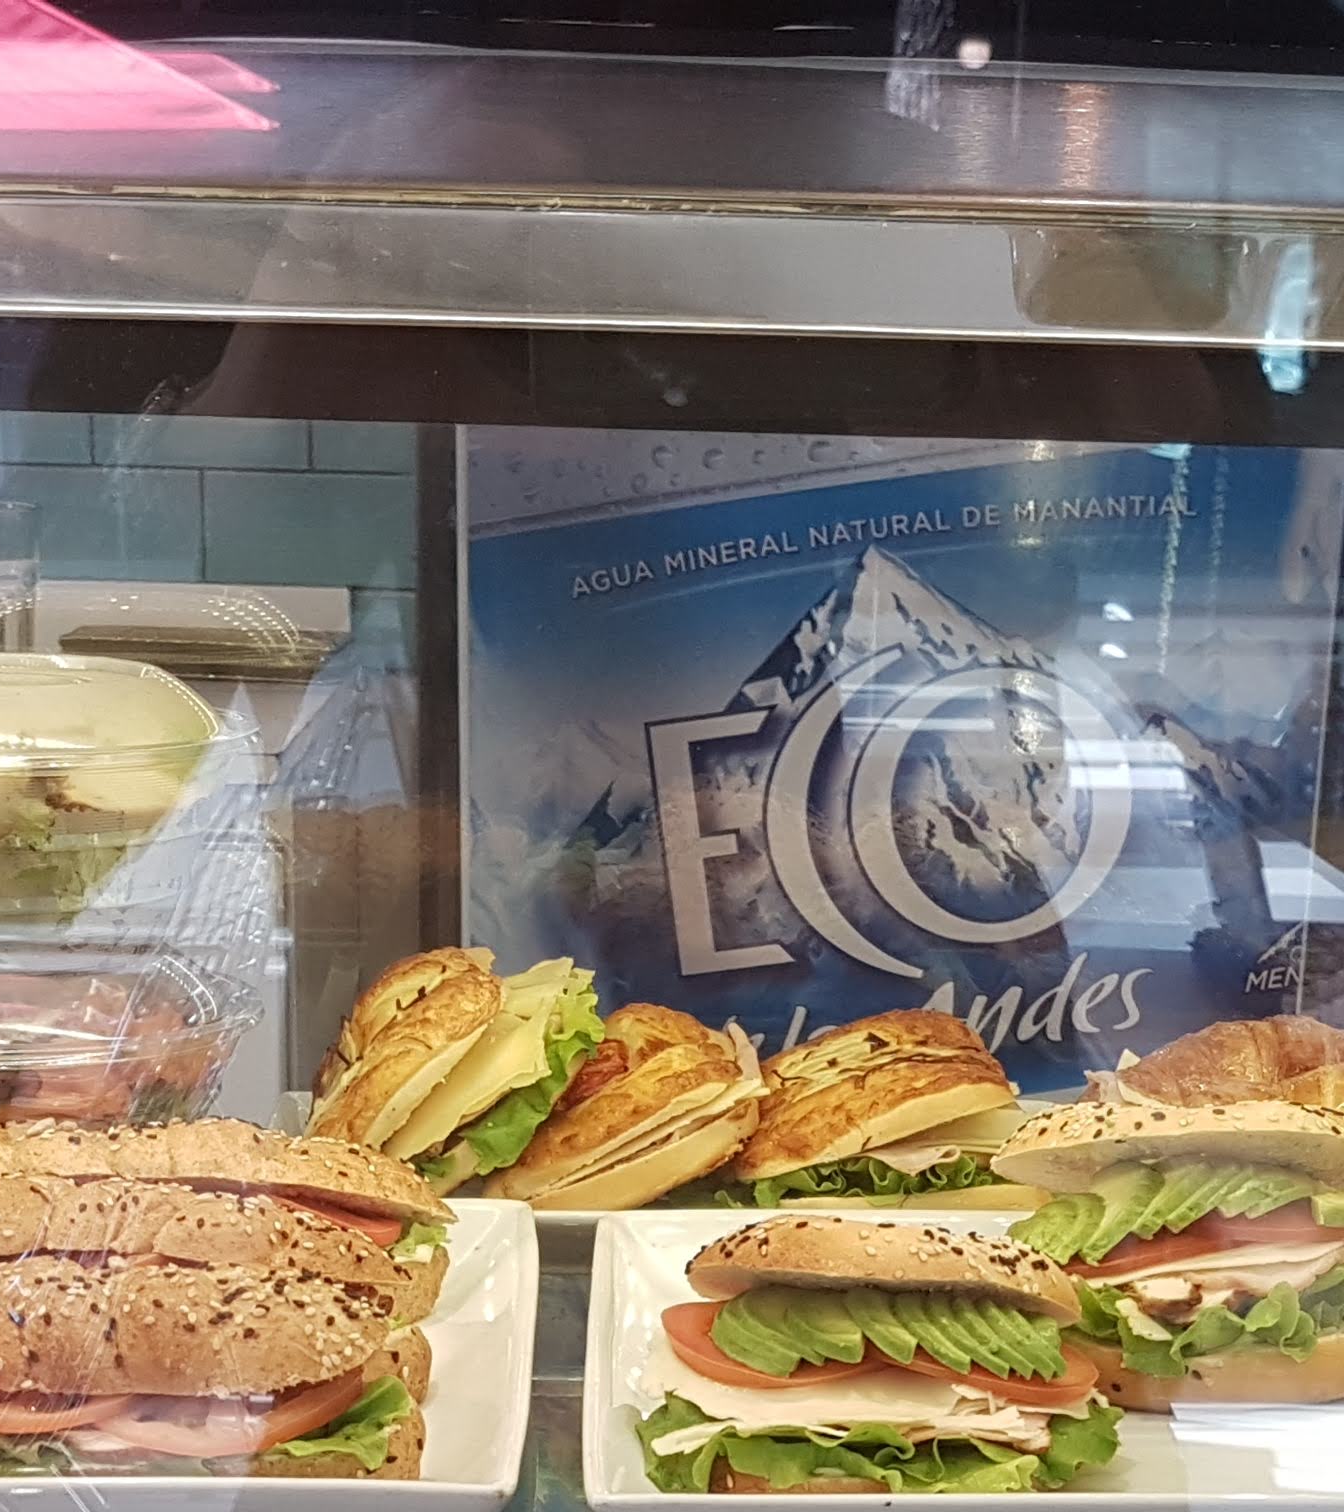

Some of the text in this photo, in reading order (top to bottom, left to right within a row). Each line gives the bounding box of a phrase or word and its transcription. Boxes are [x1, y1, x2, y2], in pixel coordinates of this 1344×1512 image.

[571, 494, 1197, 599] AGUA MINERAL NATURAL DE MANANTIAL
[644, 642, 1133, 978] ECO
